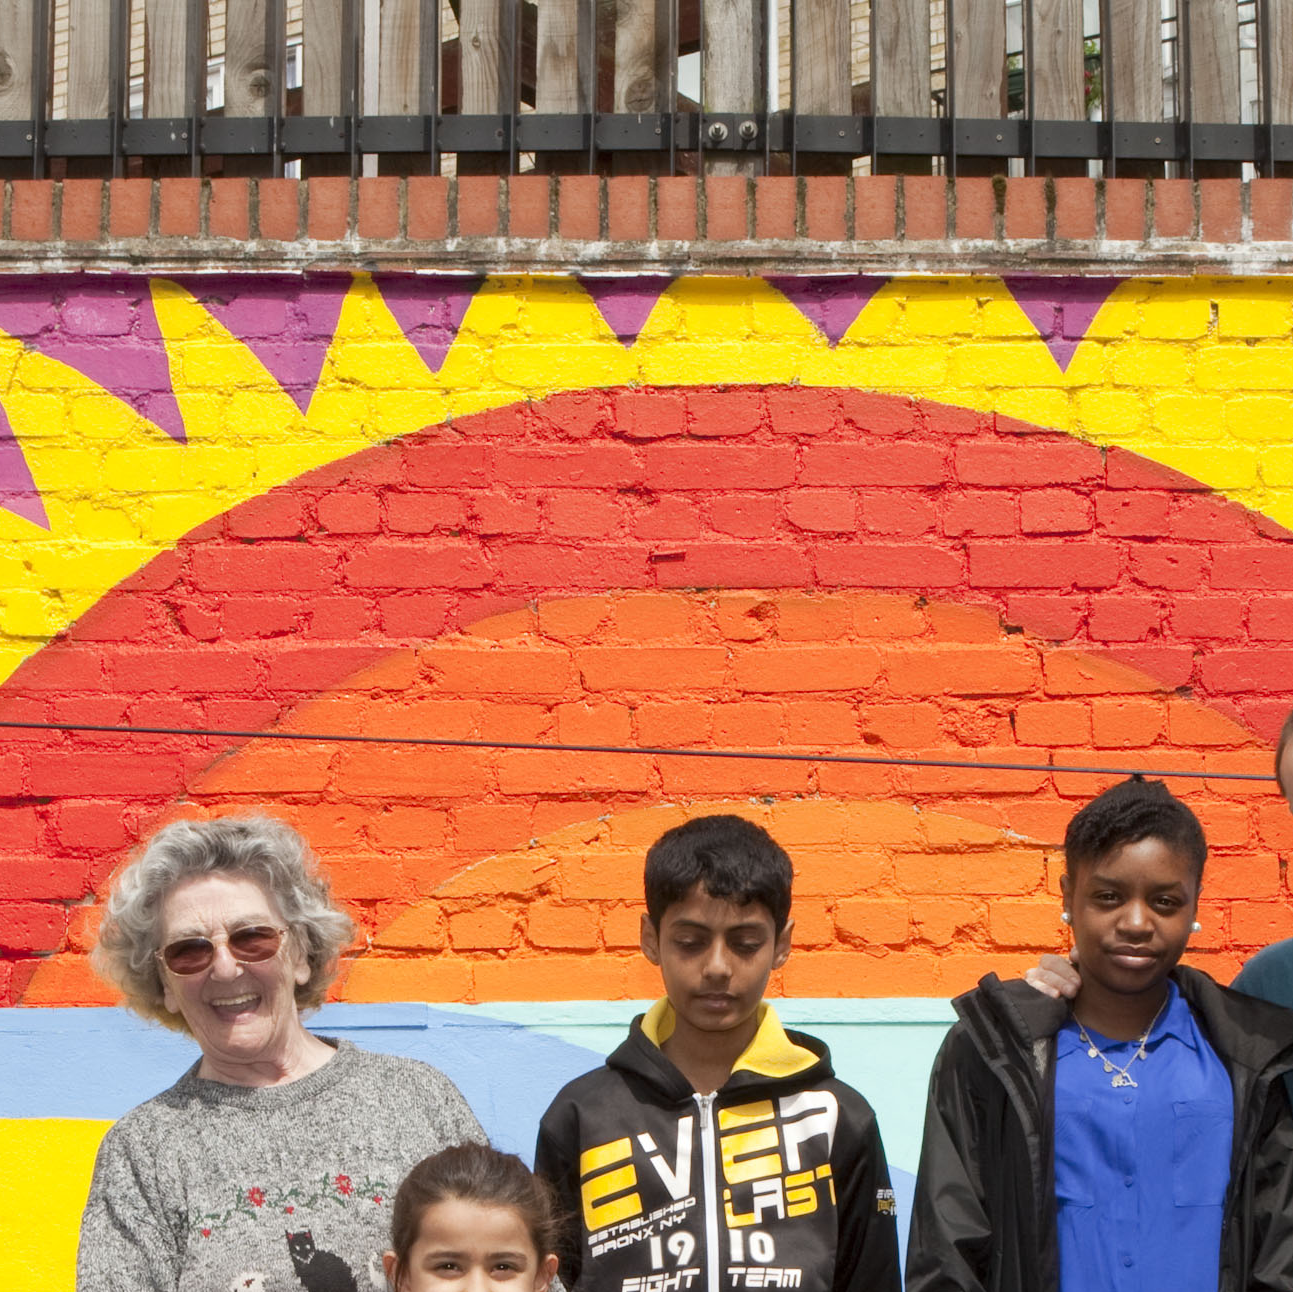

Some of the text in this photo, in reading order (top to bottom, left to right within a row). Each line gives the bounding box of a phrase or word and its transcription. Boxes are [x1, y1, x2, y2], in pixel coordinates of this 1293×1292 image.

[588, 1196, 697, 1246] ESTABLISHED
[591, 1211, 687, 1258] BRONX NY
[727, 1267, 803, 1289] TEAM
